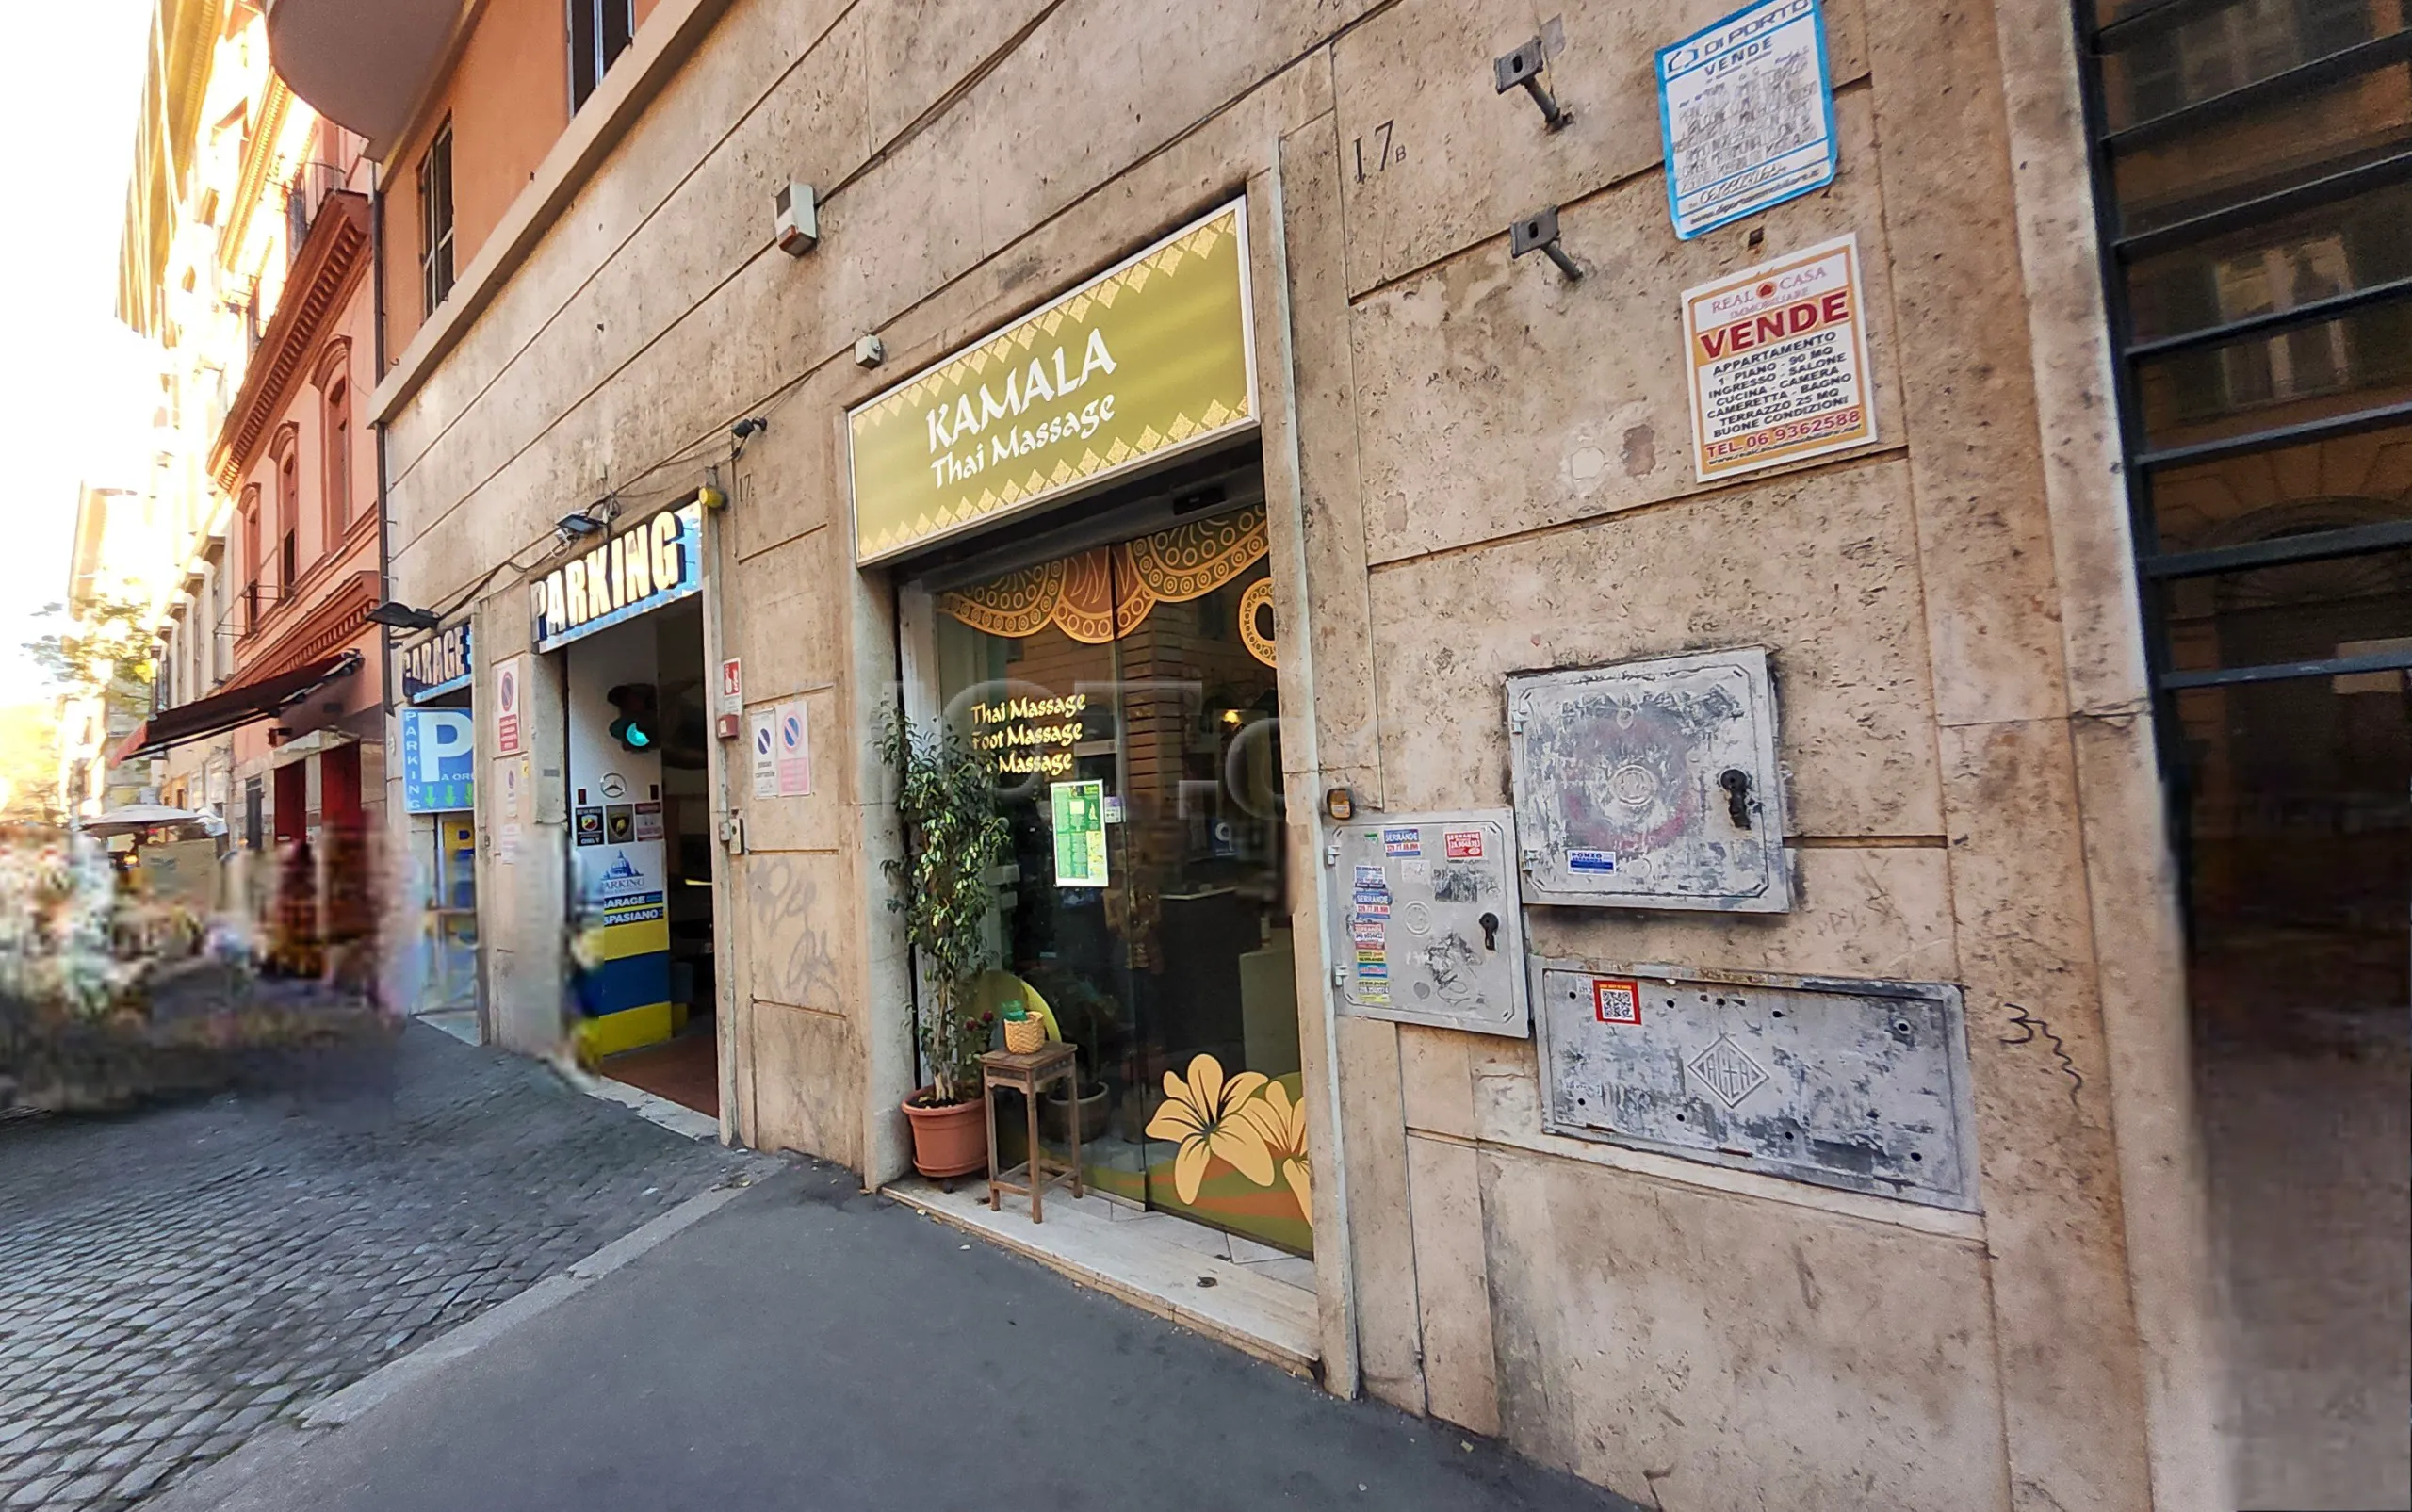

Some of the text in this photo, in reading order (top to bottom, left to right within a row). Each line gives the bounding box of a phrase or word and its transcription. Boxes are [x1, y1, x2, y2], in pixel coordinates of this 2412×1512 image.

[1704, 36, 1773, 76] VENDE
[1711, 266, 1828, 314] REAL CASA
[1700, 291, 1849, 359] VENDE
[1708, 373, 1775, 398] INGRESSO
[1788, 352, 1847, 376] SALONE
[1713, 331, 1836, 376] APPARTAMENTO
[1734, 362, 1776, 382] PIANO
[1788, 353, 1806, 366] 90
[1811, 346, 1833, 359] MQ
[925, 327, 1117, 454] KAMALA
[1706, 391, 1788, 418] CAMERETTA
[1800, 372, 1851, 394] BAGNO
[1716, 387, 1768, 406] CUCINA
[1779, 366, 1839, 389] CAMERA
[1719, 388, 1839, 426] TERRAZZO 25 MQ
[1706, 411, 1861, 458] TEL. 06 9362588
[1713, 395, 1849, 438] BUONE CONDIZIONI
[930, 394, 1116, 489] Thai Massage
[530, 512, 680, 642] PARKING
[970, 693, 1086, 725] Thai Massage
[417, 712, 474, 782] P
[971, 723, 1083, 751] Foot Massage
[405, 711, 421, 809] PARKING
[999, 753, 1073, 776] Massage
[1385, 831, 1419, 842] SERRANDE
[602, 878, 645, 890] ARKING
[1357, 894, 1390, 905] SERRANDE
